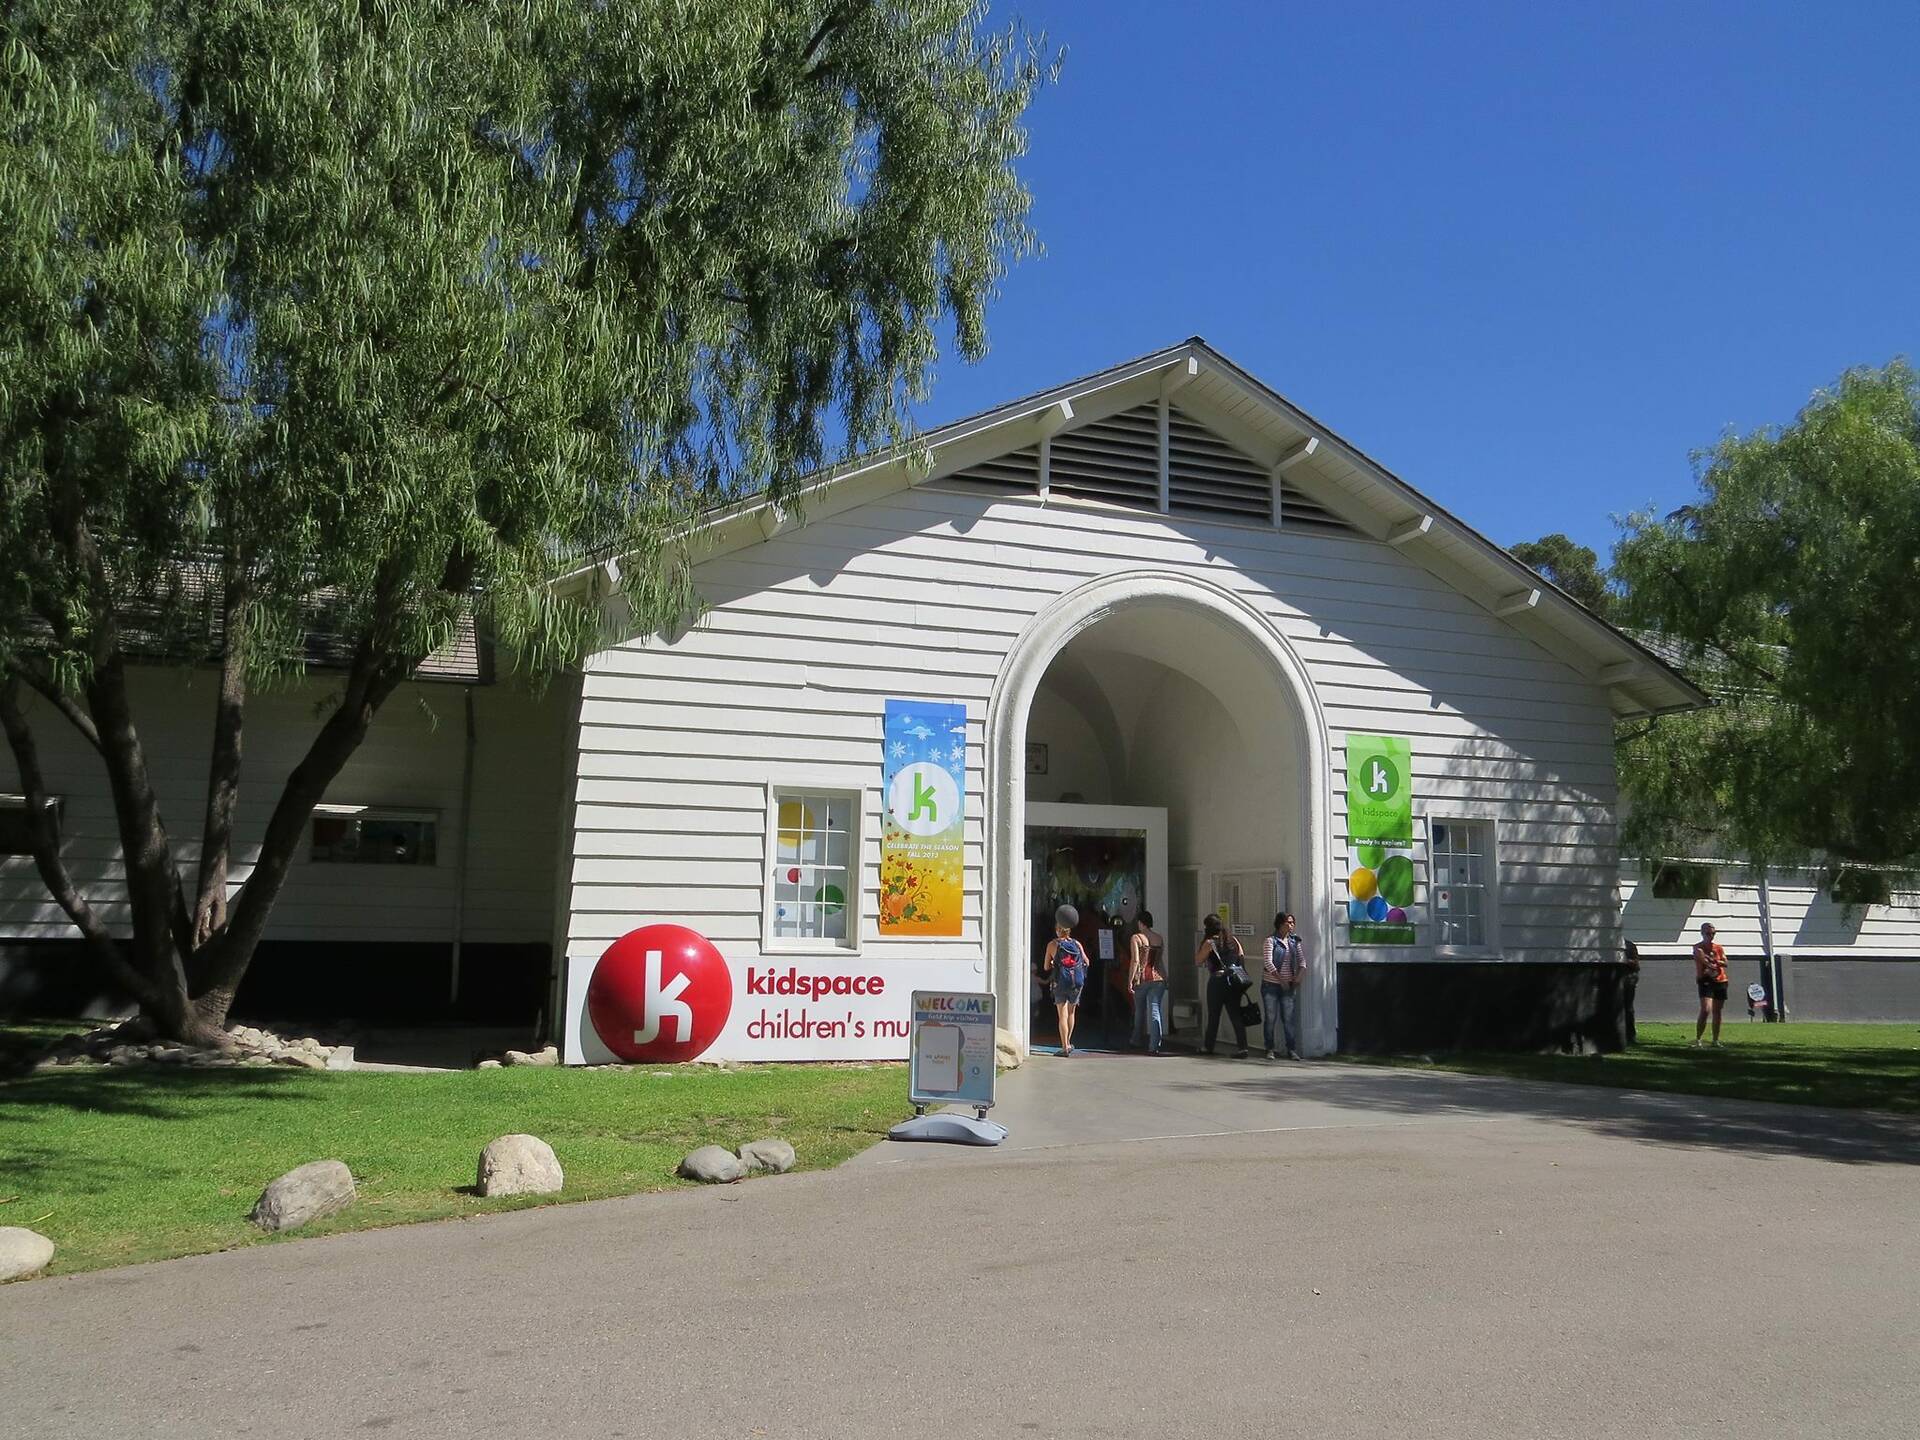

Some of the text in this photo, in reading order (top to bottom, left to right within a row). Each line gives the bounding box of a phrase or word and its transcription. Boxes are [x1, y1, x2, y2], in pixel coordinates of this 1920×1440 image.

[908, 772, 937, 822] k
[1362, 808, 1398, 818] kidspace
[1355, 838, 1373, 846] Ready
[633, 950, 693, 1044] k
[747, 967, 885, 1002] kidspace
[917, 996, 990, 1013] WELCOME
[746, 1008, 865, 1040] children's
